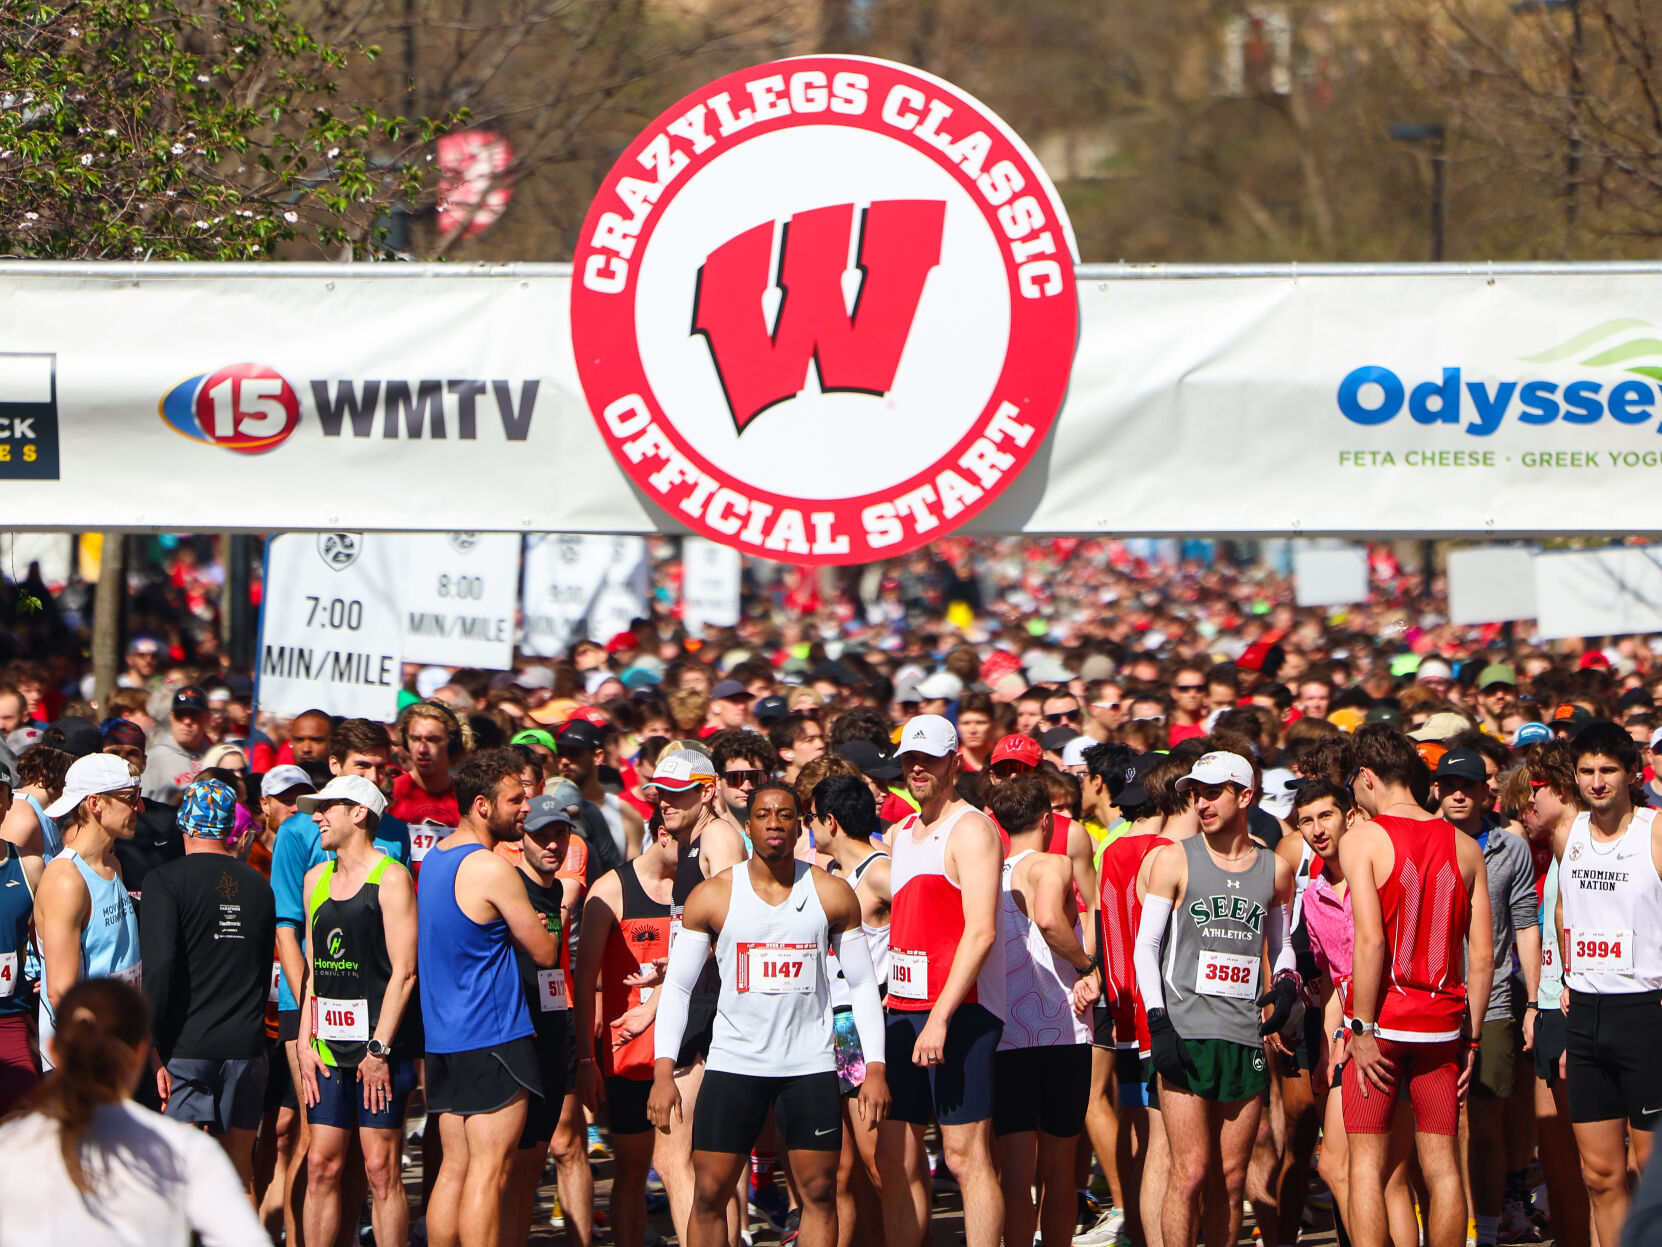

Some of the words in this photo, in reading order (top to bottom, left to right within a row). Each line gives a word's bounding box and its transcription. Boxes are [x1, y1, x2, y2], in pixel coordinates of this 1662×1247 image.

[583, 71, 869, 294] CRAZYLEGS
[882, 84, 1063, 299] CLASSIC
[690, 199, 947, 437] W
[208, 377, 288, 438] 15
[310, 379, 540, 441] WMTV
[1337, 365, 1662, 437] Odysse
[1339, 451, 1396, 467] FETA
[1404, 450, 1496, 467] CHEESE
[1521, 452, 1599, 468] GREEK
[1609, 452, 1662, 468] YOG
[603, 393, 850, 554] OFFICIAL
[861, 401, 1035, 548] START
[437, 573, 484, 601] 8:00
[306, 595, 363, 631] 7:00
[408, 612, 507, 642] MIN/MILE
[262, 645, 394, 687] MIN/MILE
[413, 834, 440, 849] 47
[1571, 869, 1630, 882] MENOMINEE
[1579, 880, 1616, 891] NATION
[1189, 894, 1268, 935] SEEK
[1202, 927, 1253, 941] ATHLETICS
[1576, 940, 1622, 958] 3994
[763, 961, 803, 978] 1147
[893, 964, 911, 983] 1191
[1205, 963, 1251, 984] 3582
[325, 1009, 355, 1027] 4116
